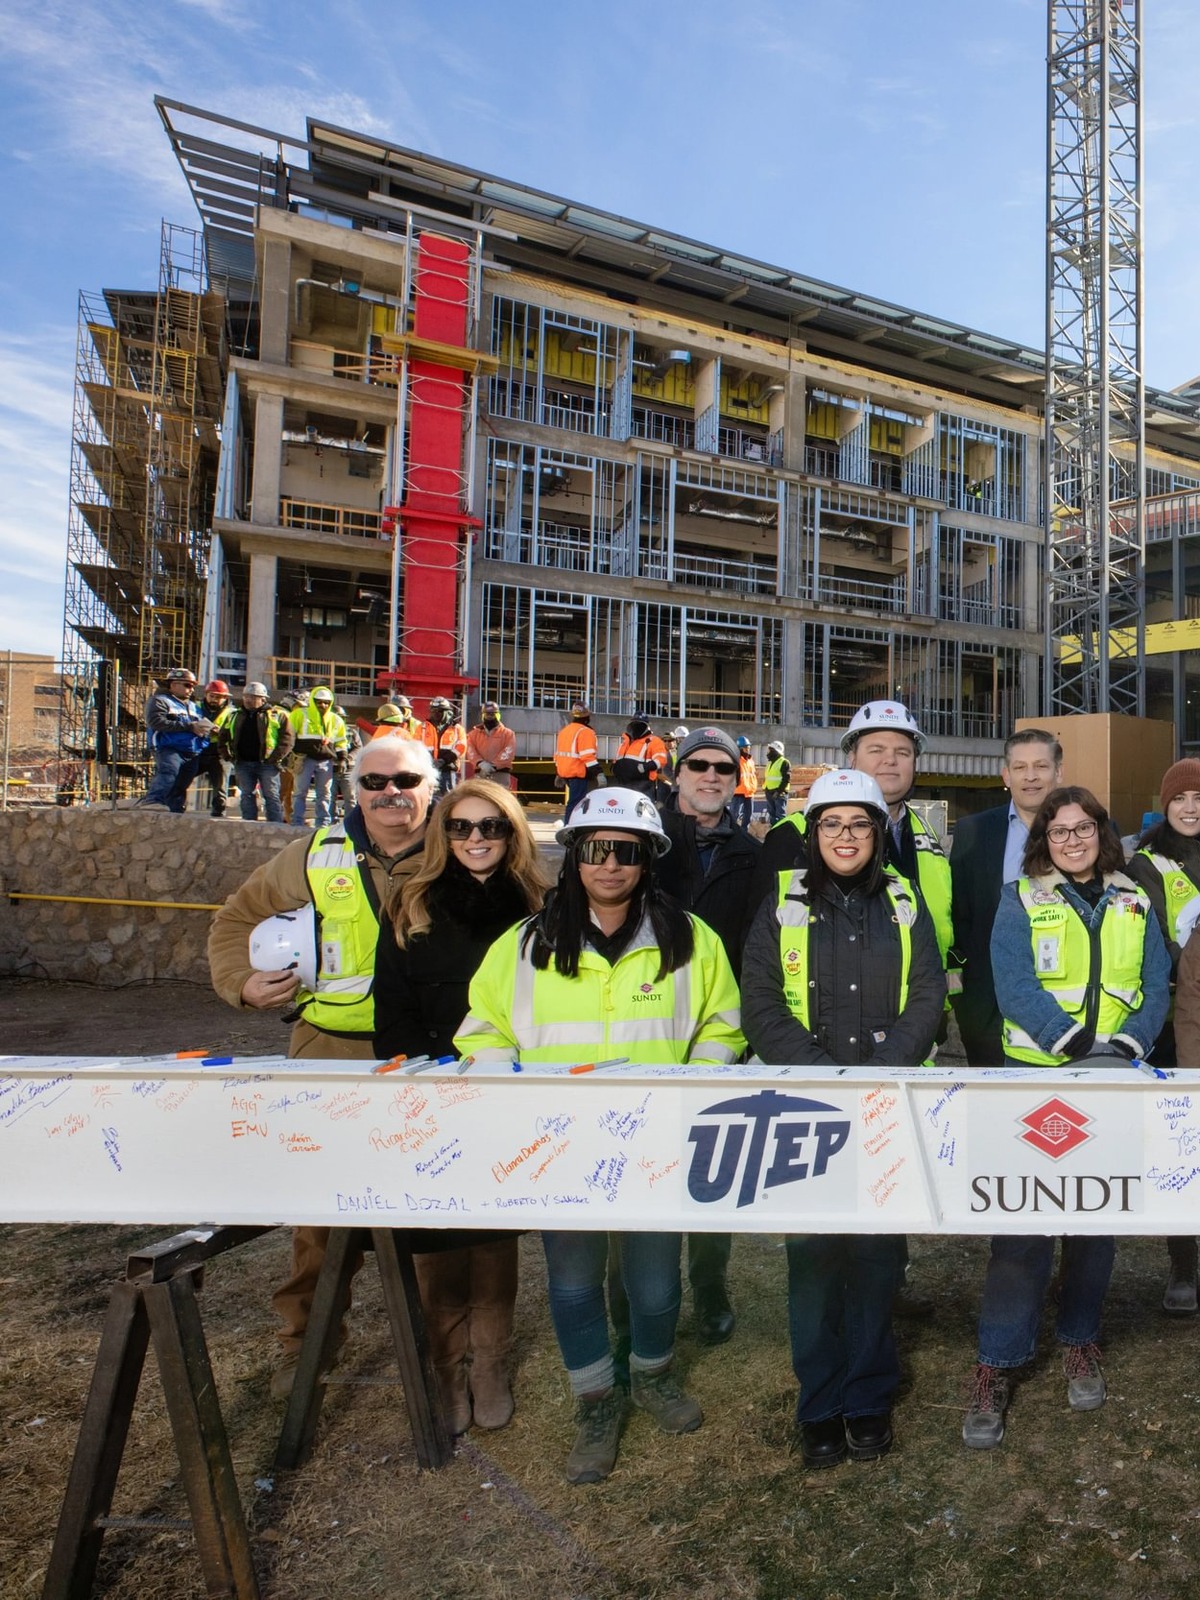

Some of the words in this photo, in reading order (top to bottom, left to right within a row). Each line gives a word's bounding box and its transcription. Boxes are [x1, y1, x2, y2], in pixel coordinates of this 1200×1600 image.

[632, 994, 662, 1002] SUNDT
[231, 1120, 268, 1139] EMV
[687, 1089, 851, 1208] UTEP
[337, 1190, 398, 1212] DANIEL
[970, 1175, 1141, 1213] SUNDT
